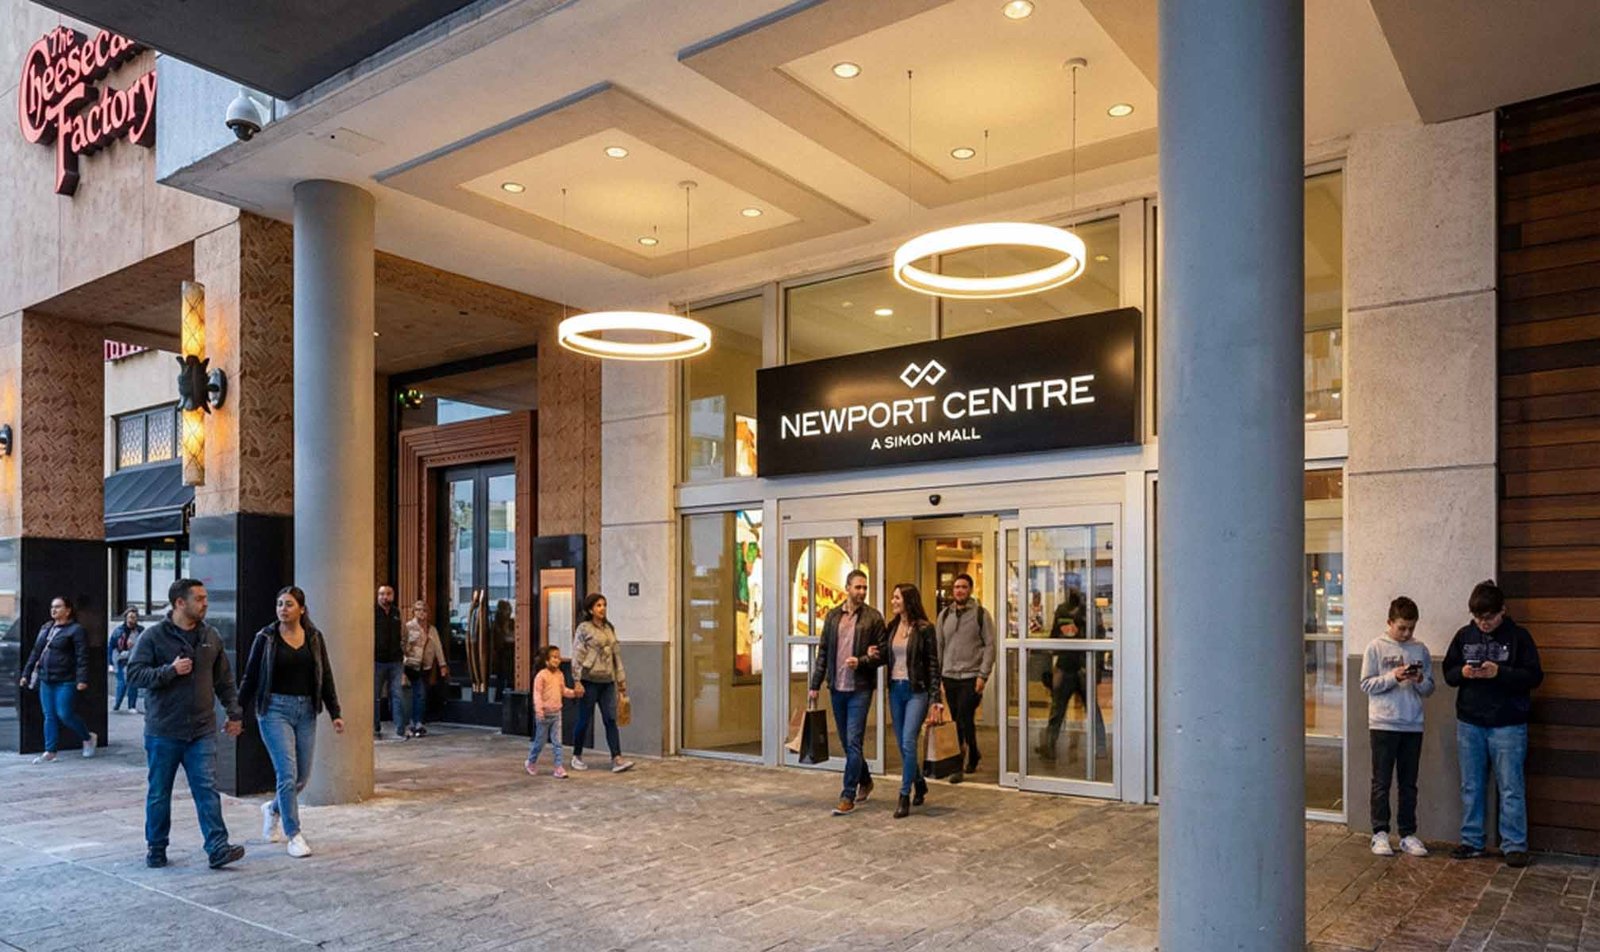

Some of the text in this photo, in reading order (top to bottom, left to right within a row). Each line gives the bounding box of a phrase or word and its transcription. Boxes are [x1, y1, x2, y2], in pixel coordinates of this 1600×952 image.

[51, 27, 75, 58] The
[19, 29, 136, 144] Cheeseca
[45, 71, 156, 195] Factory
[780, 374, 1095, 440] NEWPORT CENTRE
[870, 427, 981, 451] A SIMON MALL
